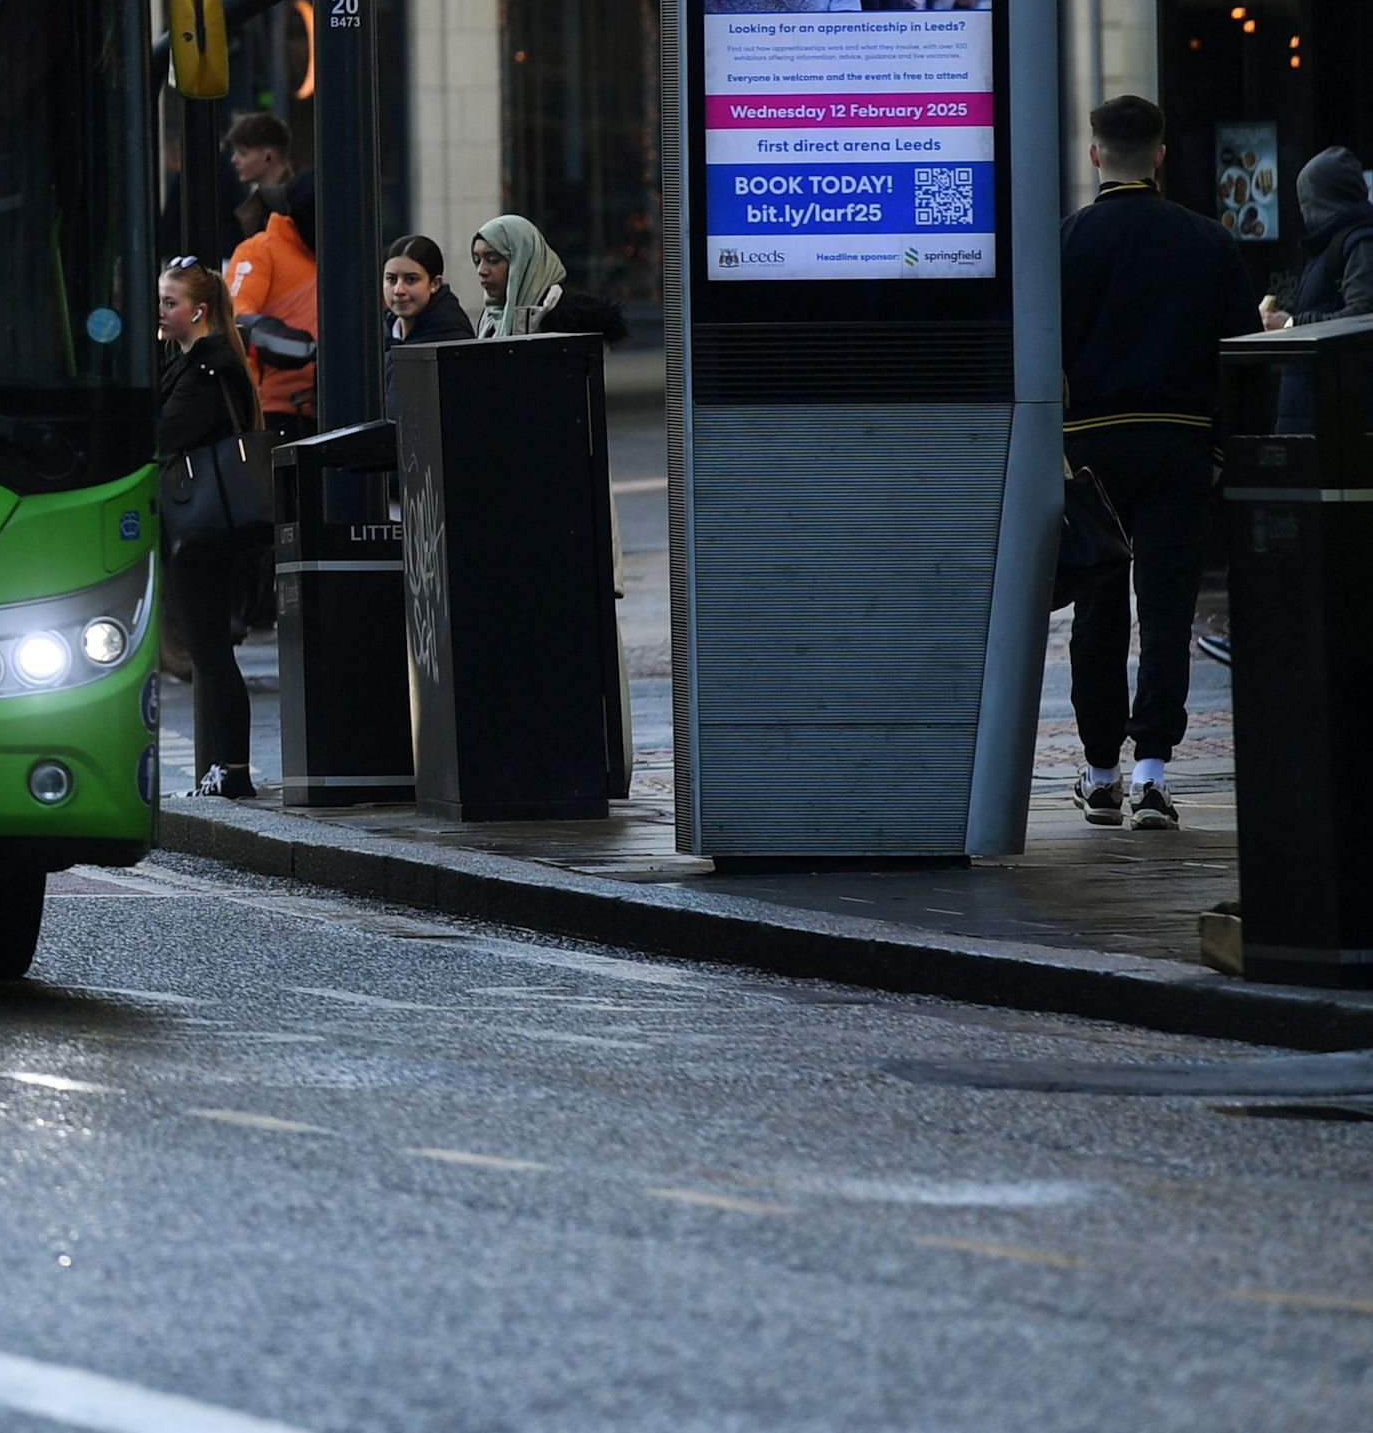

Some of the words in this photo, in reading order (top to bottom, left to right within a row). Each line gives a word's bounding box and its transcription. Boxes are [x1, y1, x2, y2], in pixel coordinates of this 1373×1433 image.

[330, 16, 361, 28] B473
[729, 23, 776, 36] Looking
[779, 23, 795, 34] for
[799, 24, 815, 34] an
[818, 21, 908, 36] apprenticeship
[910, 22, 922, 32] in
[924, 21, 966, 32] Leeds?
[727, 73, 771, 84] Everyone
[772, 73, 781, 82] is
[785, 73, 824, 82] welcome
[826, 72, 844, 82] and
[847, 72, 863, 81] the
[864, 73, 892, 81] event
[893, 71, 901, 81] is
[903, 71, 922, 81] free
[924, 72, 935, 80] to
[936, 71, 969, 80] attend
[730, 105, 826, 121] Wednesday
[829, 105, 846, 118] 12
[850, 104, 924, 120] February
[926, 103, 968, 116] 2025
[757, 139, 789, 153] first
[793, 139, 839, 153] direct
[843, 140, 891, 152] arena
[895, 138, 942, 151] Leeds
[734, 176, 804, 195] BOOK
[808, 175, 894, 194] TODAY!
[746, 202, 883, 227] bit.ly/larf25
[740, 250, 786, 263] Leeds
[816, 252, 859, 262] Headline
[860, 253, 901, 263] sponsor:
[924, 249, 982, 263] springfield
